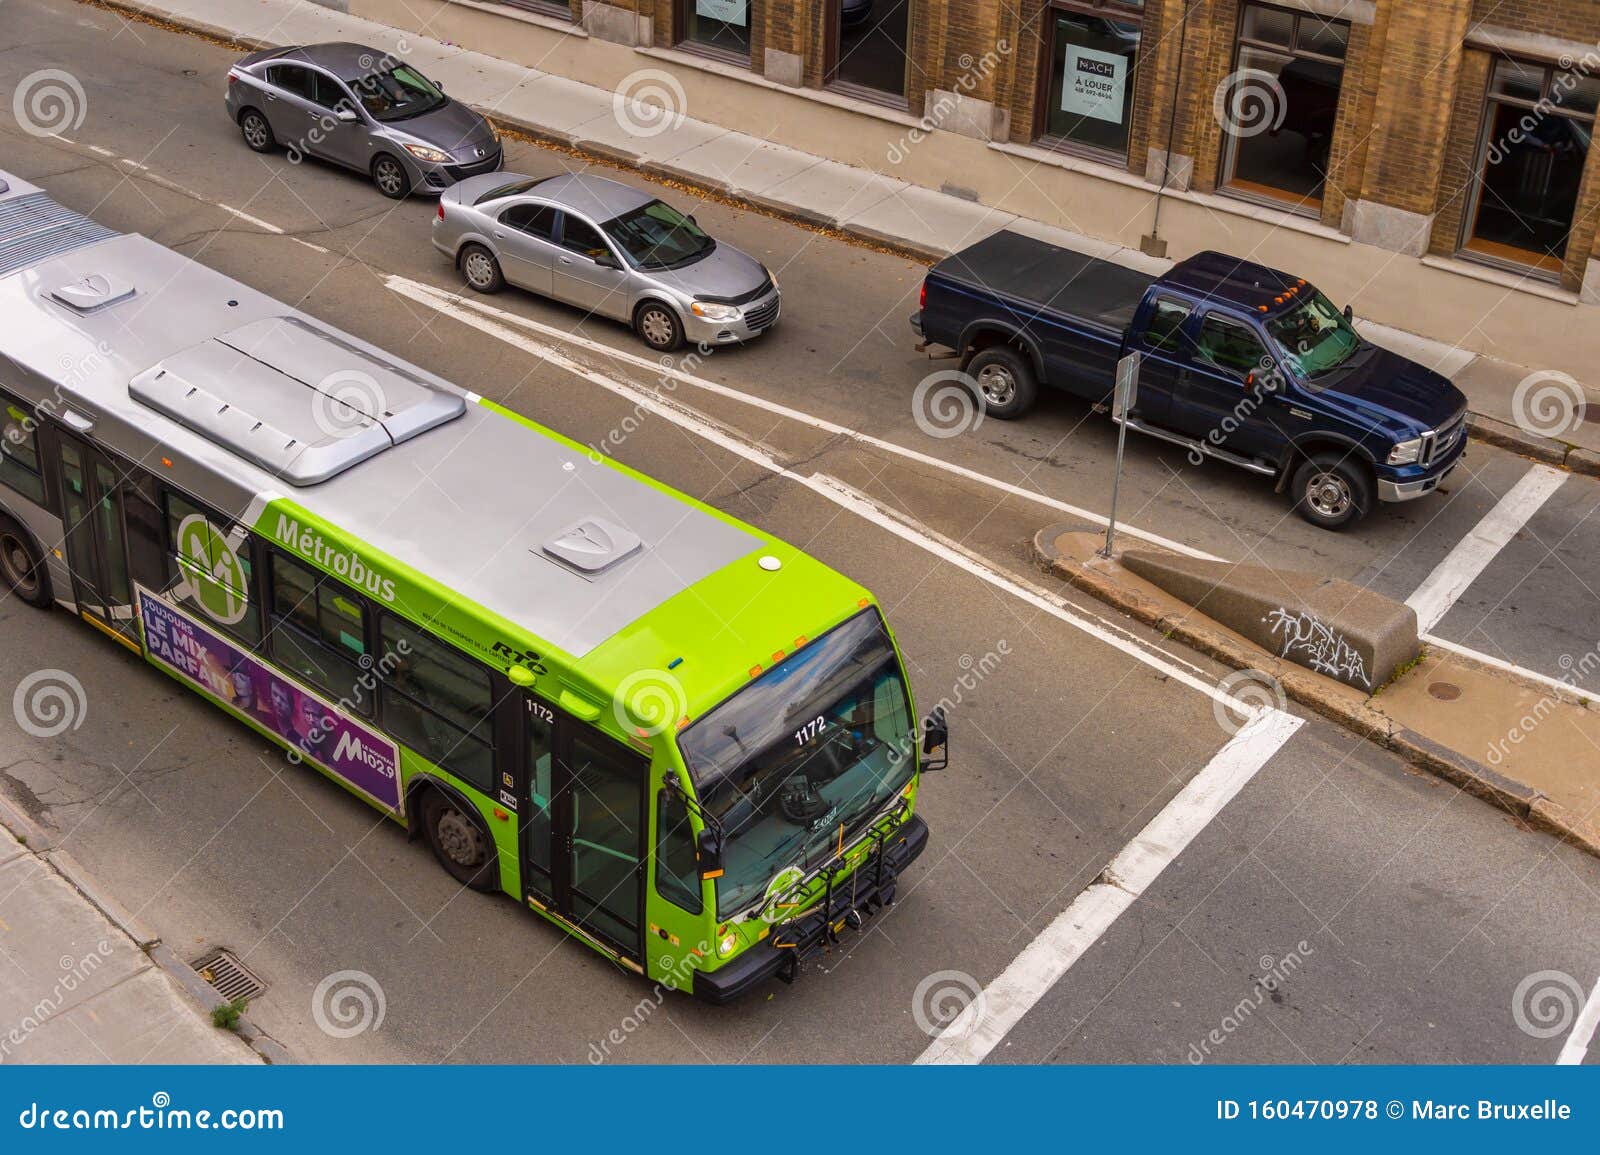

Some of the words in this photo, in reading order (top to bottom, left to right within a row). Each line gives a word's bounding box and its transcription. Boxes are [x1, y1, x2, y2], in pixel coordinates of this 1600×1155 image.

[1084, 79, 1113, 92] LOUER
[276, 513, 396, 602] Métrobus
[143, 597, 193, 635] TOUJOURS
[144, 608, 168, 639] LE
[172, 626, 209, 664] MIX
[492, 641, 548, 675] RTC
[526, 699, 554, 724] 1172
[795, 715, 827, 746] 1172
